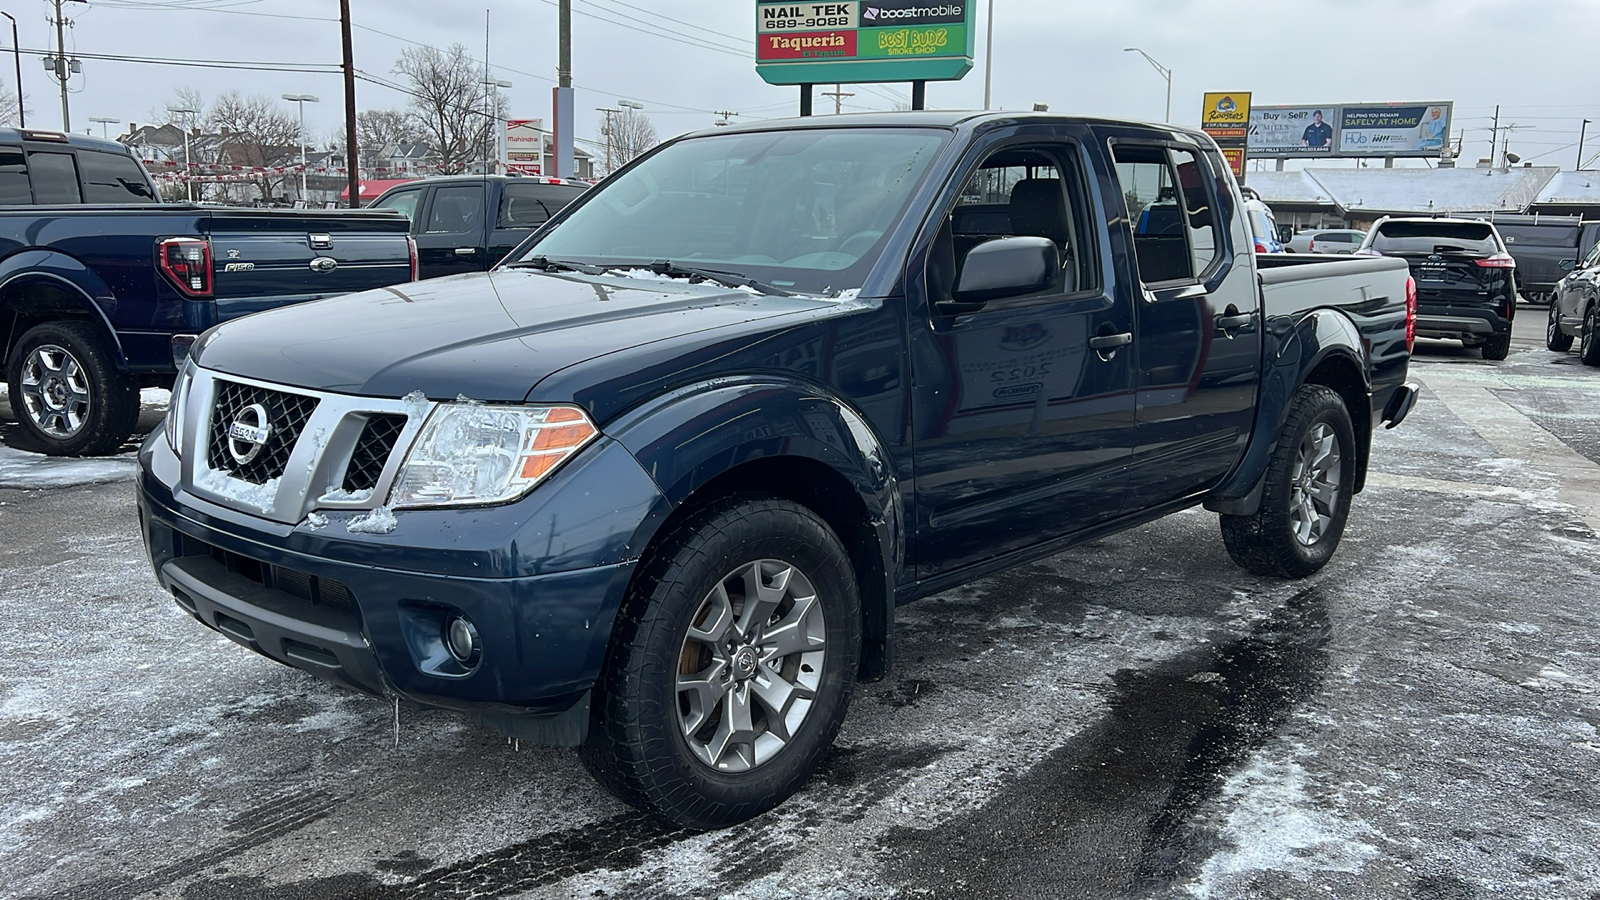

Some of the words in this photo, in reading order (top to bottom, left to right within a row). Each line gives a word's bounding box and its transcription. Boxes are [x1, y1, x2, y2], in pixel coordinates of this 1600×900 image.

[764, 7, 804, 19] NAIL
[812, 4, 849, 16] TEK
[765, 17, 848, 29] 689-9088
[888, 47, 914, 55] SMOKE
[915, 46, 936, 54] SHOP
[1207, 110, 1244, 121] Roosters
[1263, 112, 1279, 120] Buy
[1288, 111, 1308, 119] Sell?
